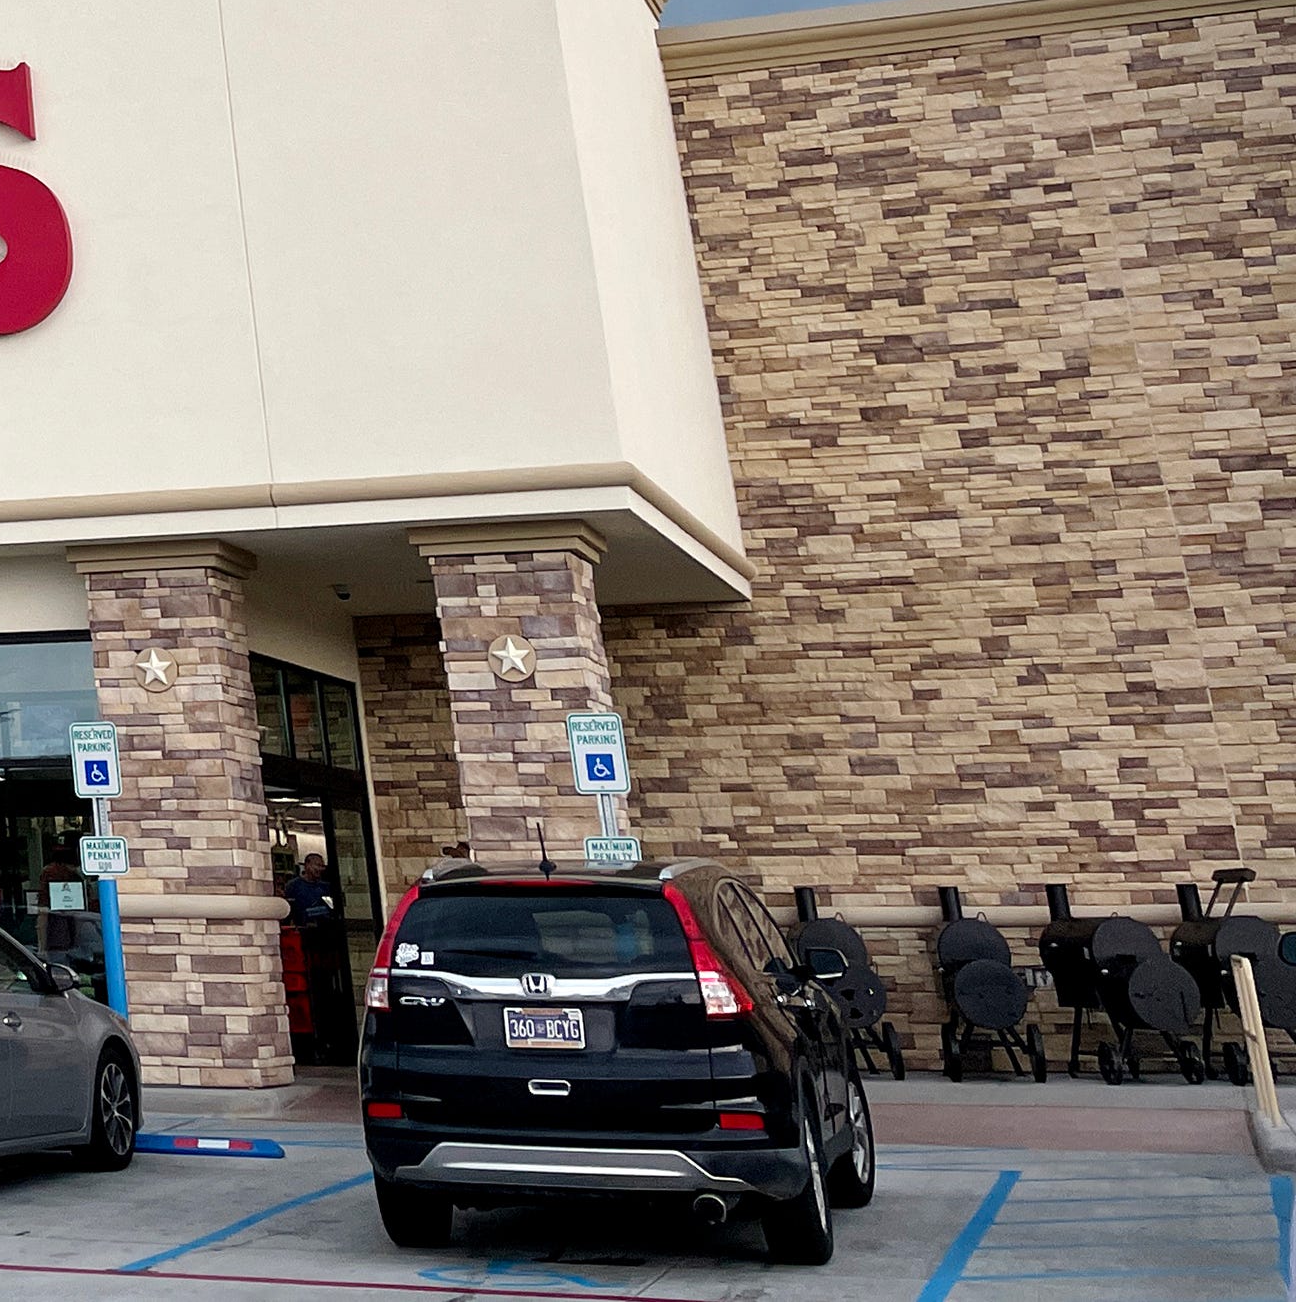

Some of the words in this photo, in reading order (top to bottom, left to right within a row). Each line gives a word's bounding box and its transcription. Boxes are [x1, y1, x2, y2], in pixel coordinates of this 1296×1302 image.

[571, 720, 618, 732] RESERVED
[73, 729, 113, 740] RESERVED
[576, 734, 617, 745] PARKING
[77, 742, 111, 752] PARKING
[86, 841, 122, 850] MAXIMUM
[591, 841, 633, 851] MAXIMUM
[87, 851, 121, 860] PENALTY
[593, 853, 632, 861] PENALTY
[509, 1019, 536, 1038] 360
[546, 1019, 580, 1039] BCYG
